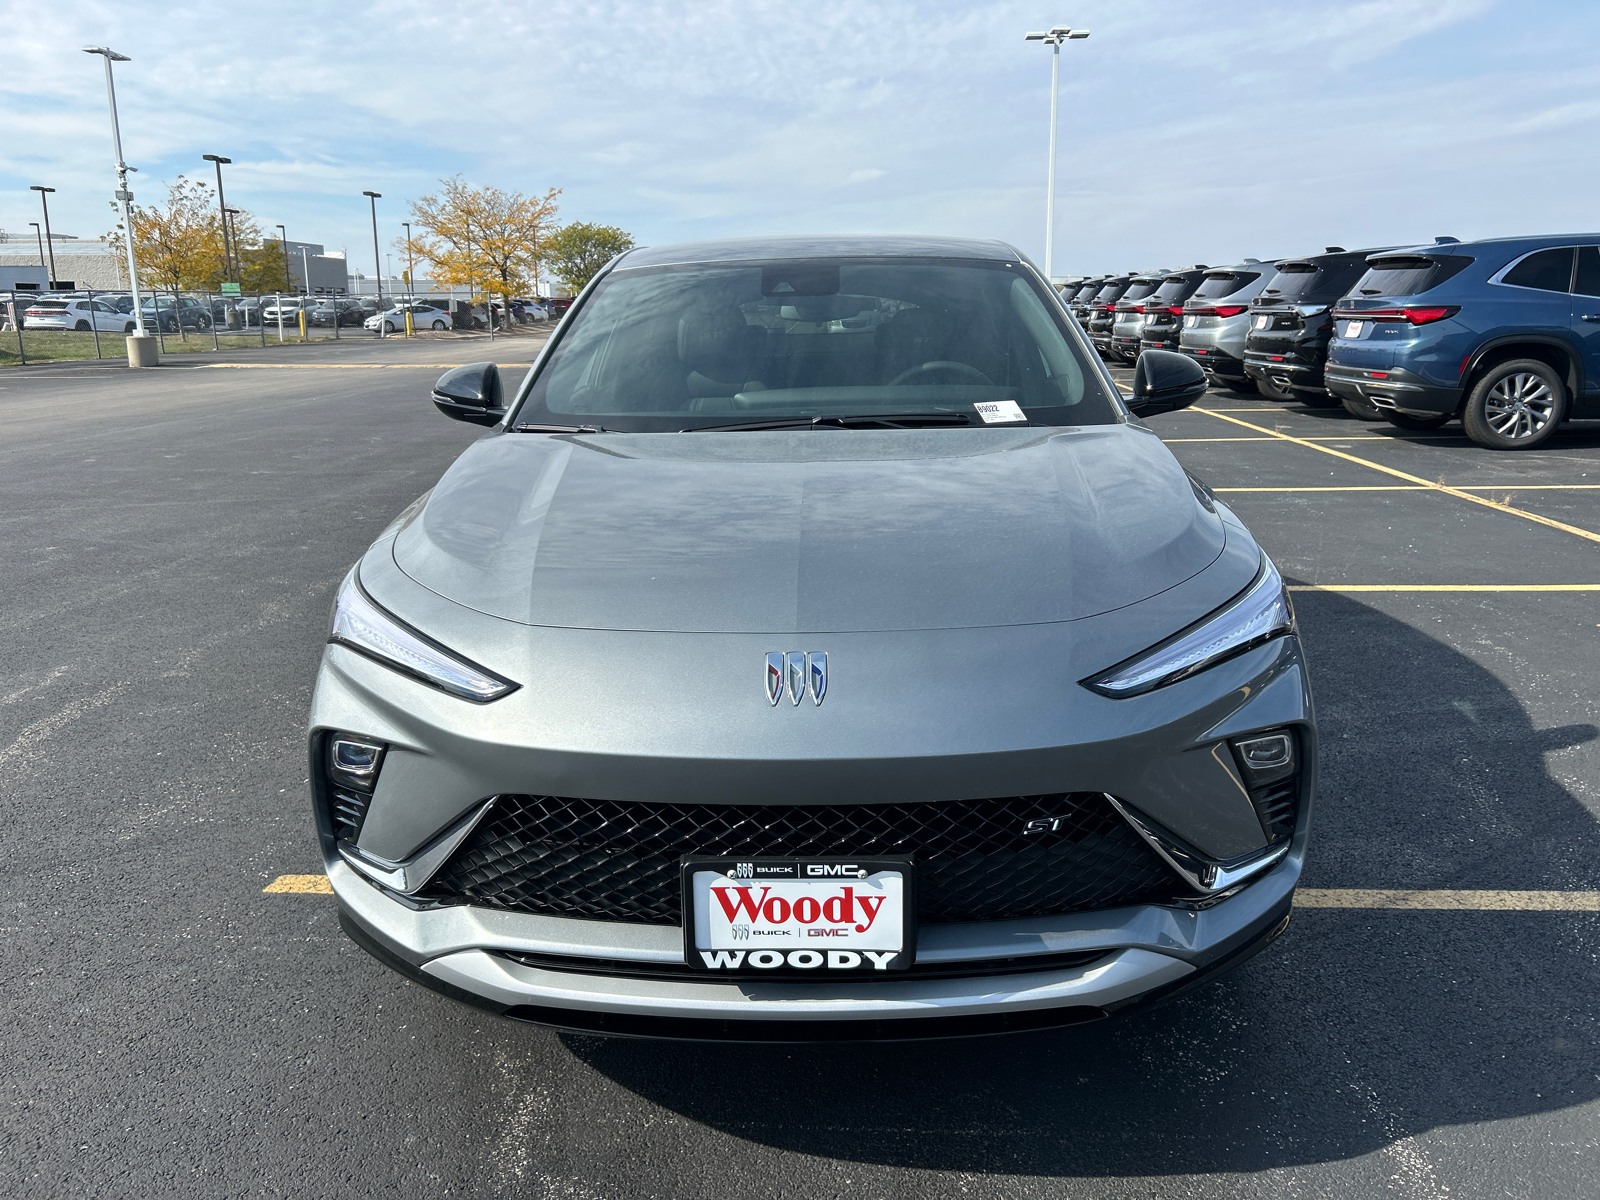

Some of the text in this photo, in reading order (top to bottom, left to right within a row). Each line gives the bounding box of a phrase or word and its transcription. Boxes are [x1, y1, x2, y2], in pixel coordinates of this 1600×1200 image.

[756, 864, 859, 876] BUICK GMC
[709, 886, 887, 933] Woody
[807, 928, 849, 937] GMC
[699, 950, 900, 970] WOODY
